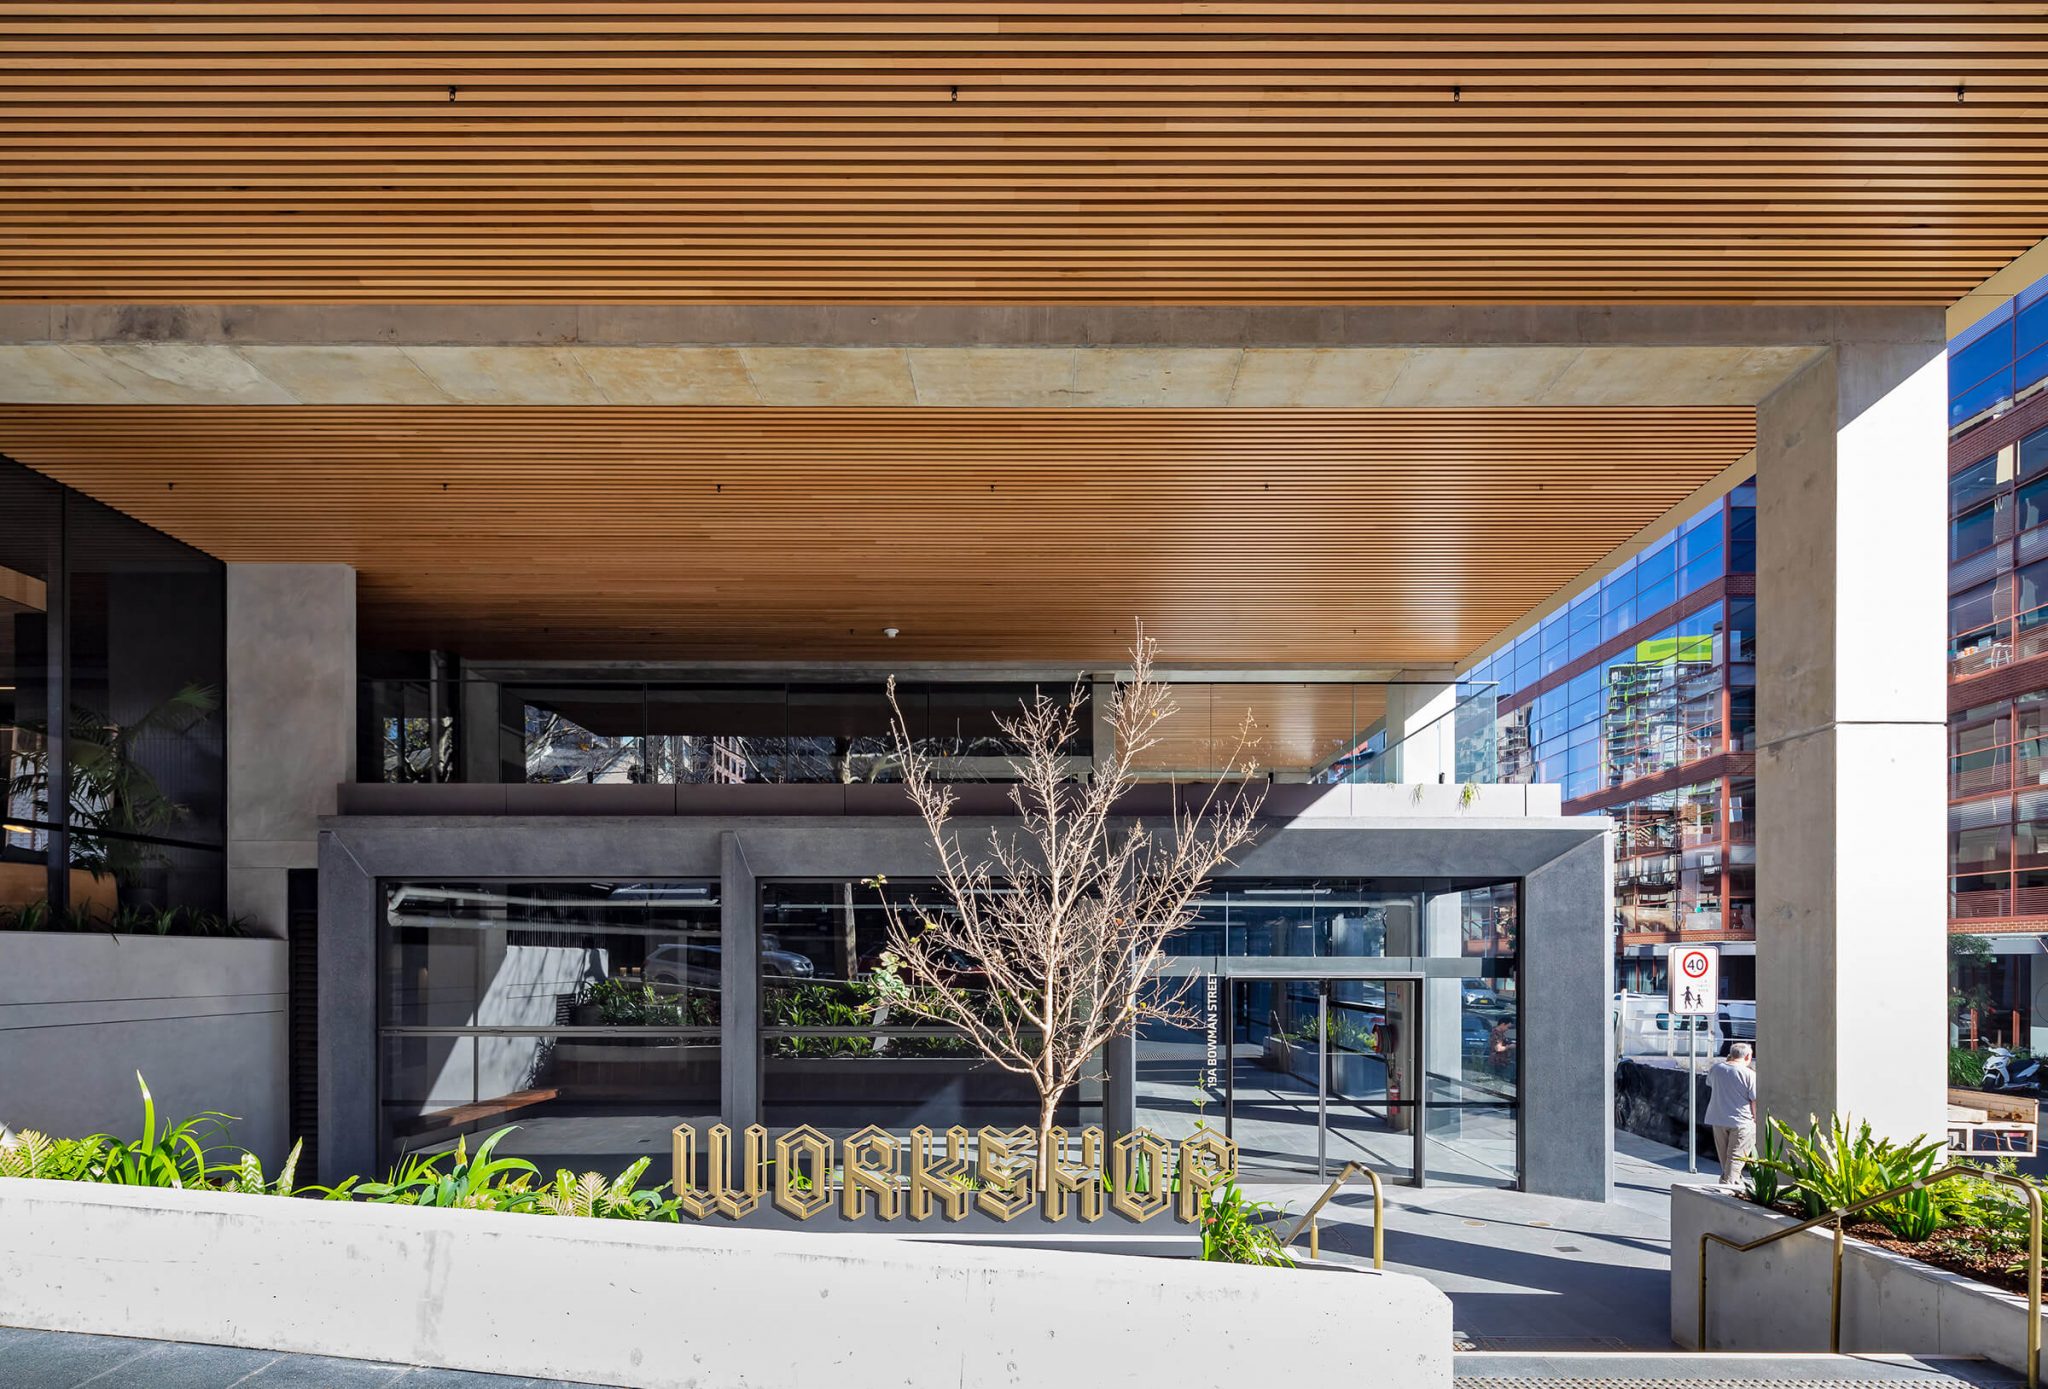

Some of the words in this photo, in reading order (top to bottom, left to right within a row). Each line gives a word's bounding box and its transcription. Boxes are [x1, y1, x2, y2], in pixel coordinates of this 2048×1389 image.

[1687, 959, 1704, 970] 40
[1207, 971, 1217, 1011] STREET
[1207, 1014, 1217, 1065] BOWMAN
[1207, 1068, 1217, 1087] 19A
[672, 1123, 1238, 1222] WORKSHOP
